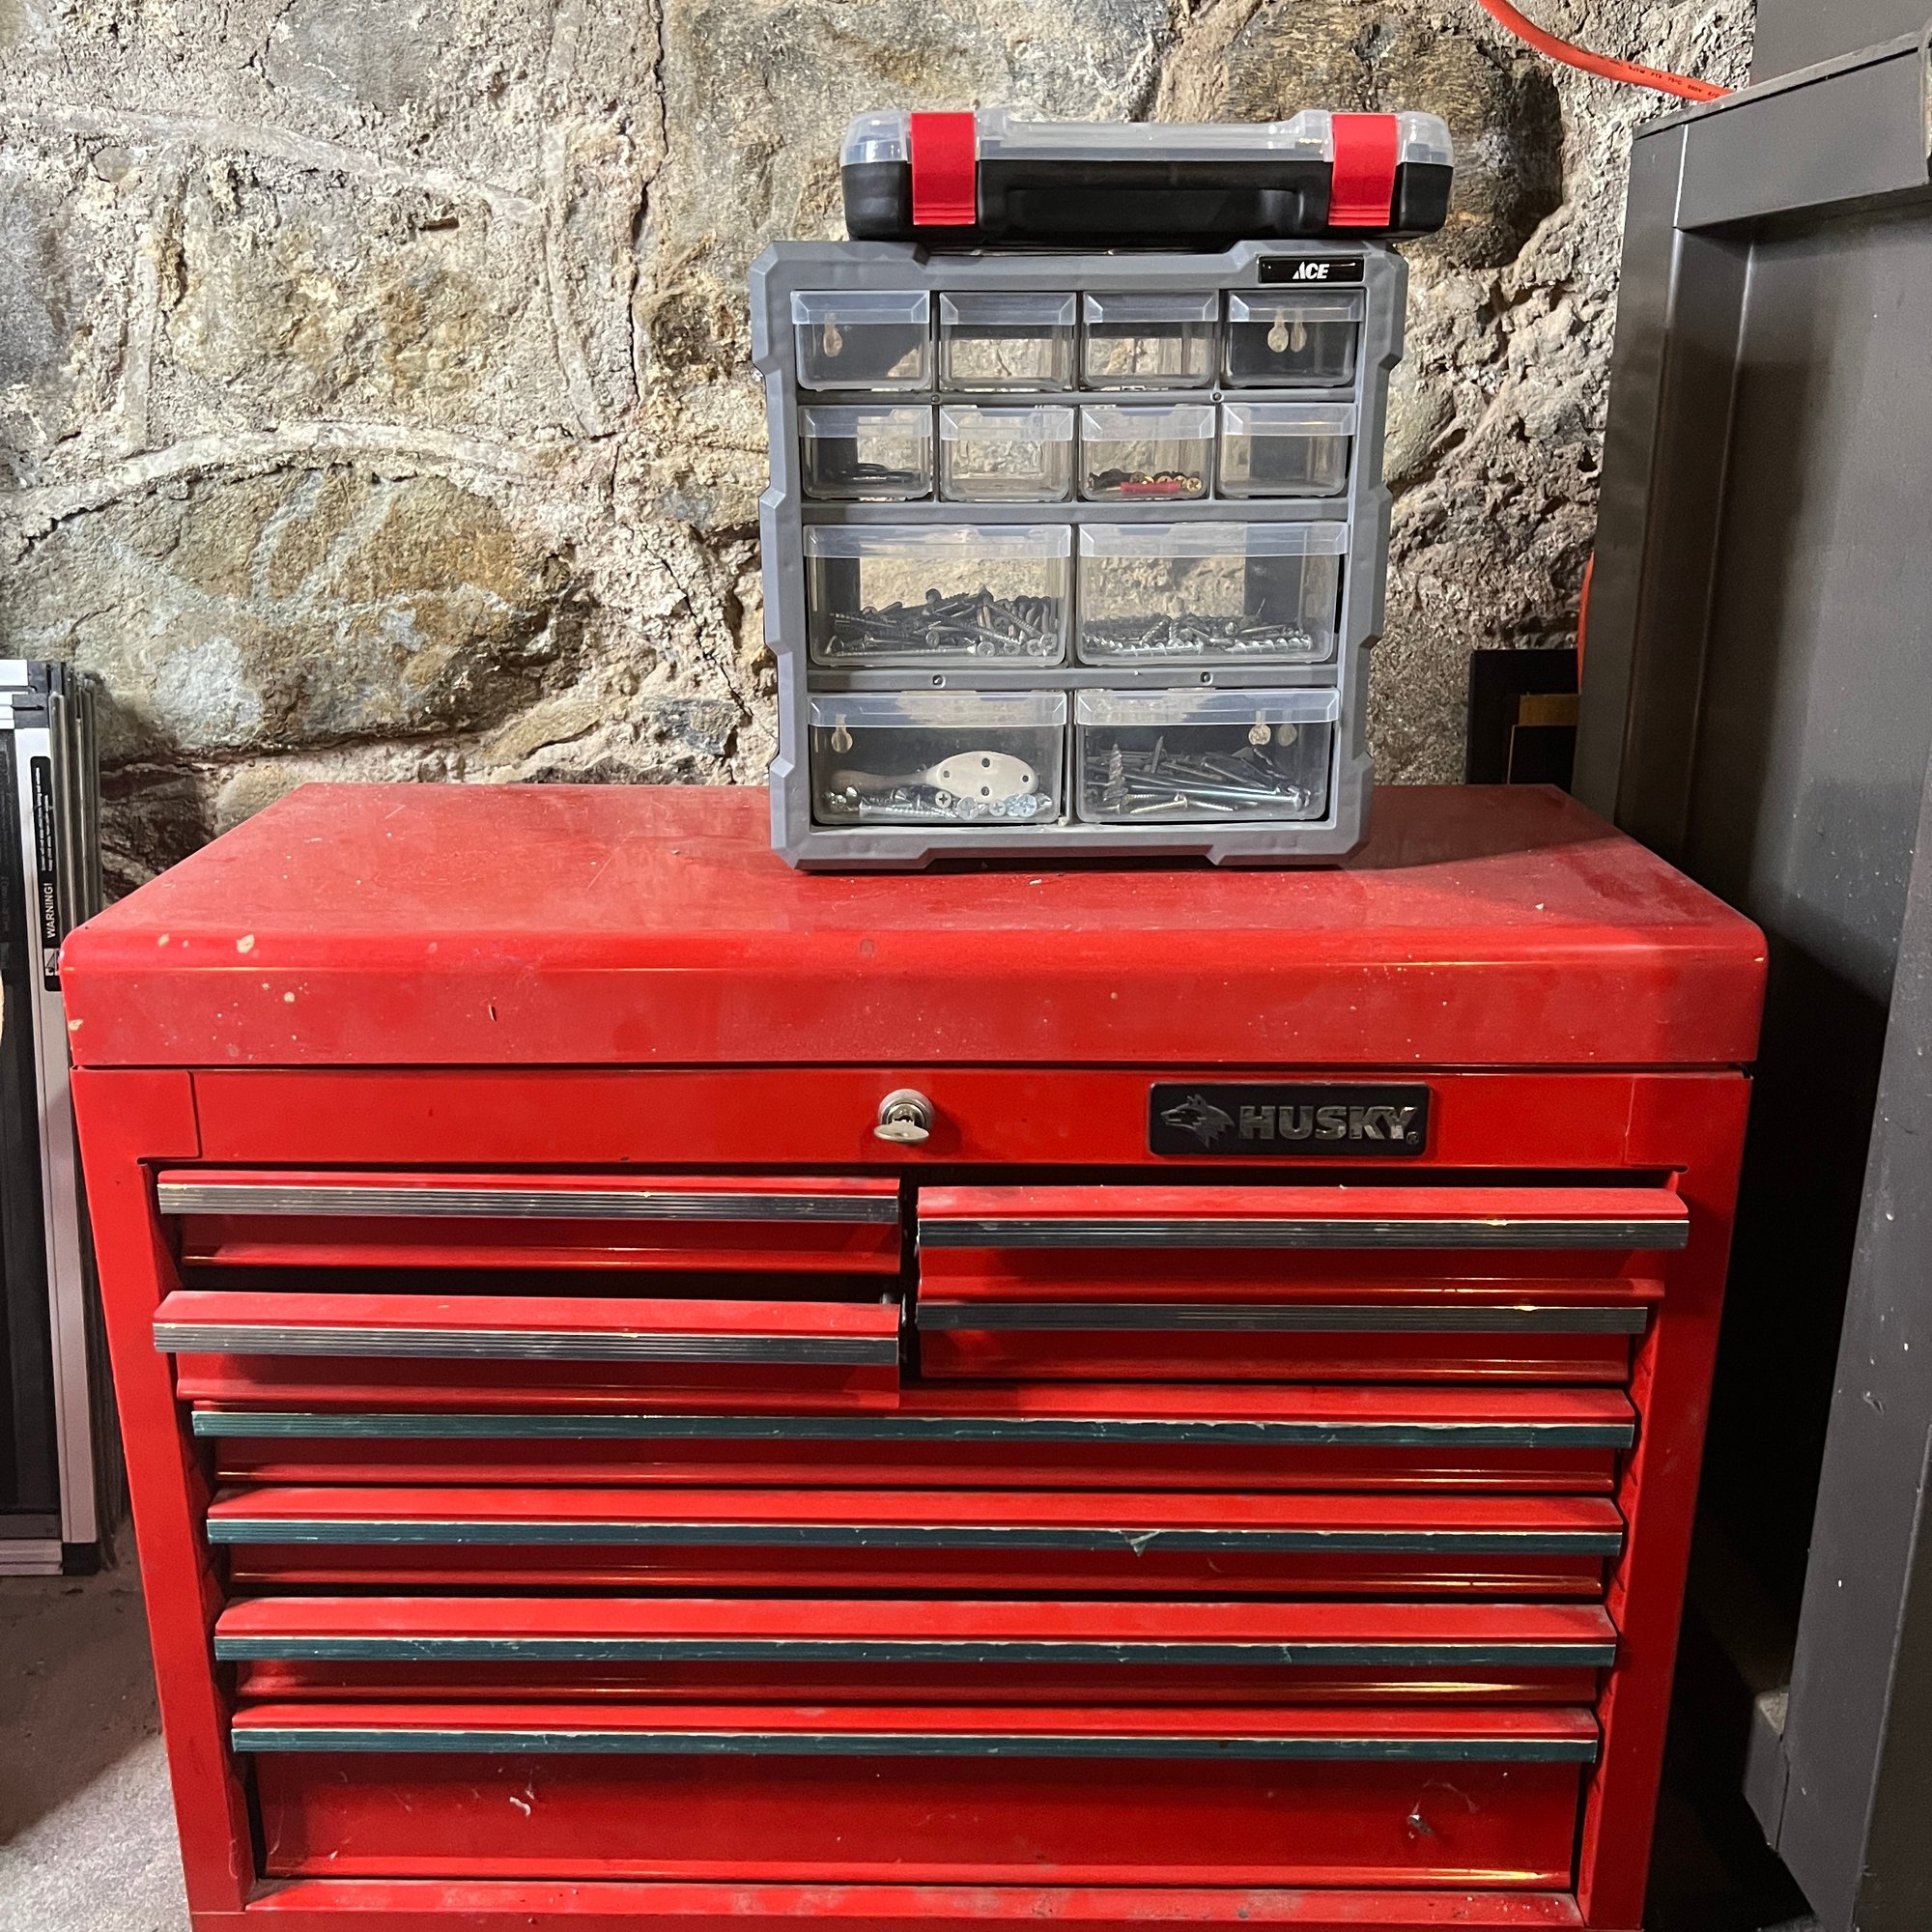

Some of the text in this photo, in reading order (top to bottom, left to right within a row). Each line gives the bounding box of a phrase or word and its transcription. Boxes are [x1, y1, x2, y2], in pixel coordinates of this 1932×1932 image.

[1292, 261, 1330, 279] ACE
[44, 882, 56, 938] WARNING!
[1239, 1105, 1418, 1140] HUSKY
